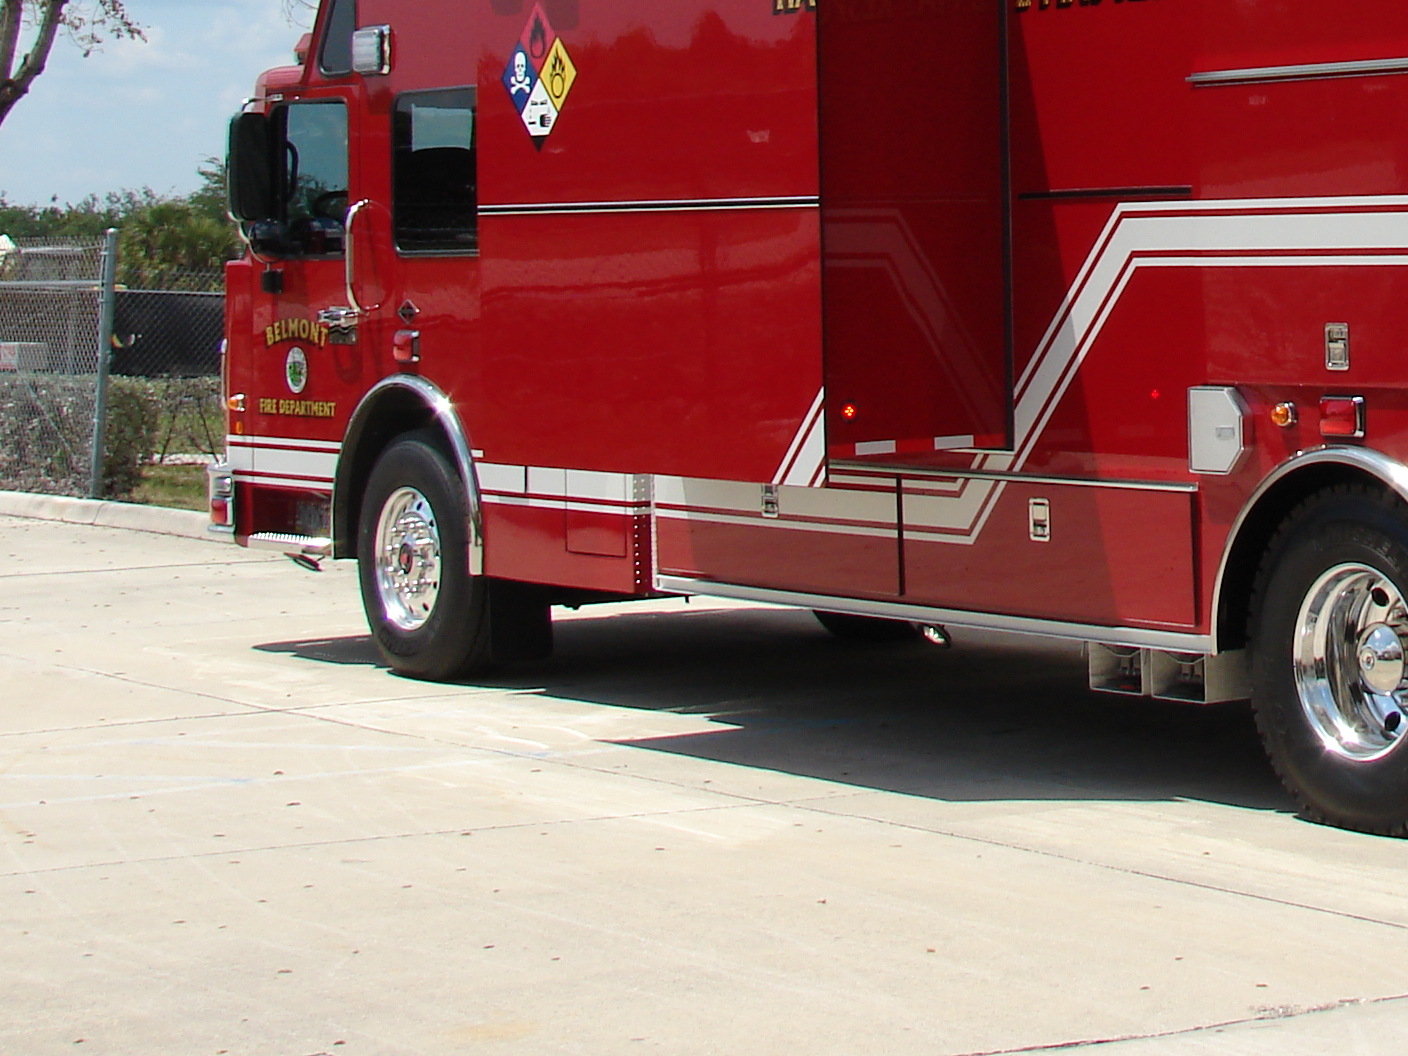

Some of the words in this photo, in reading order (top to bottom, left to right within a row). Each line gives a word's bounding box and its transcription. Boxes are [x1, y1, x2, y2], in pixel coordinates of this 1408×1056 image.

[265, 318, 329, 347] BELMONT
[259, 398, 277, 414] FIRE
[279, 400, 337, 417] DEPARTMENT
